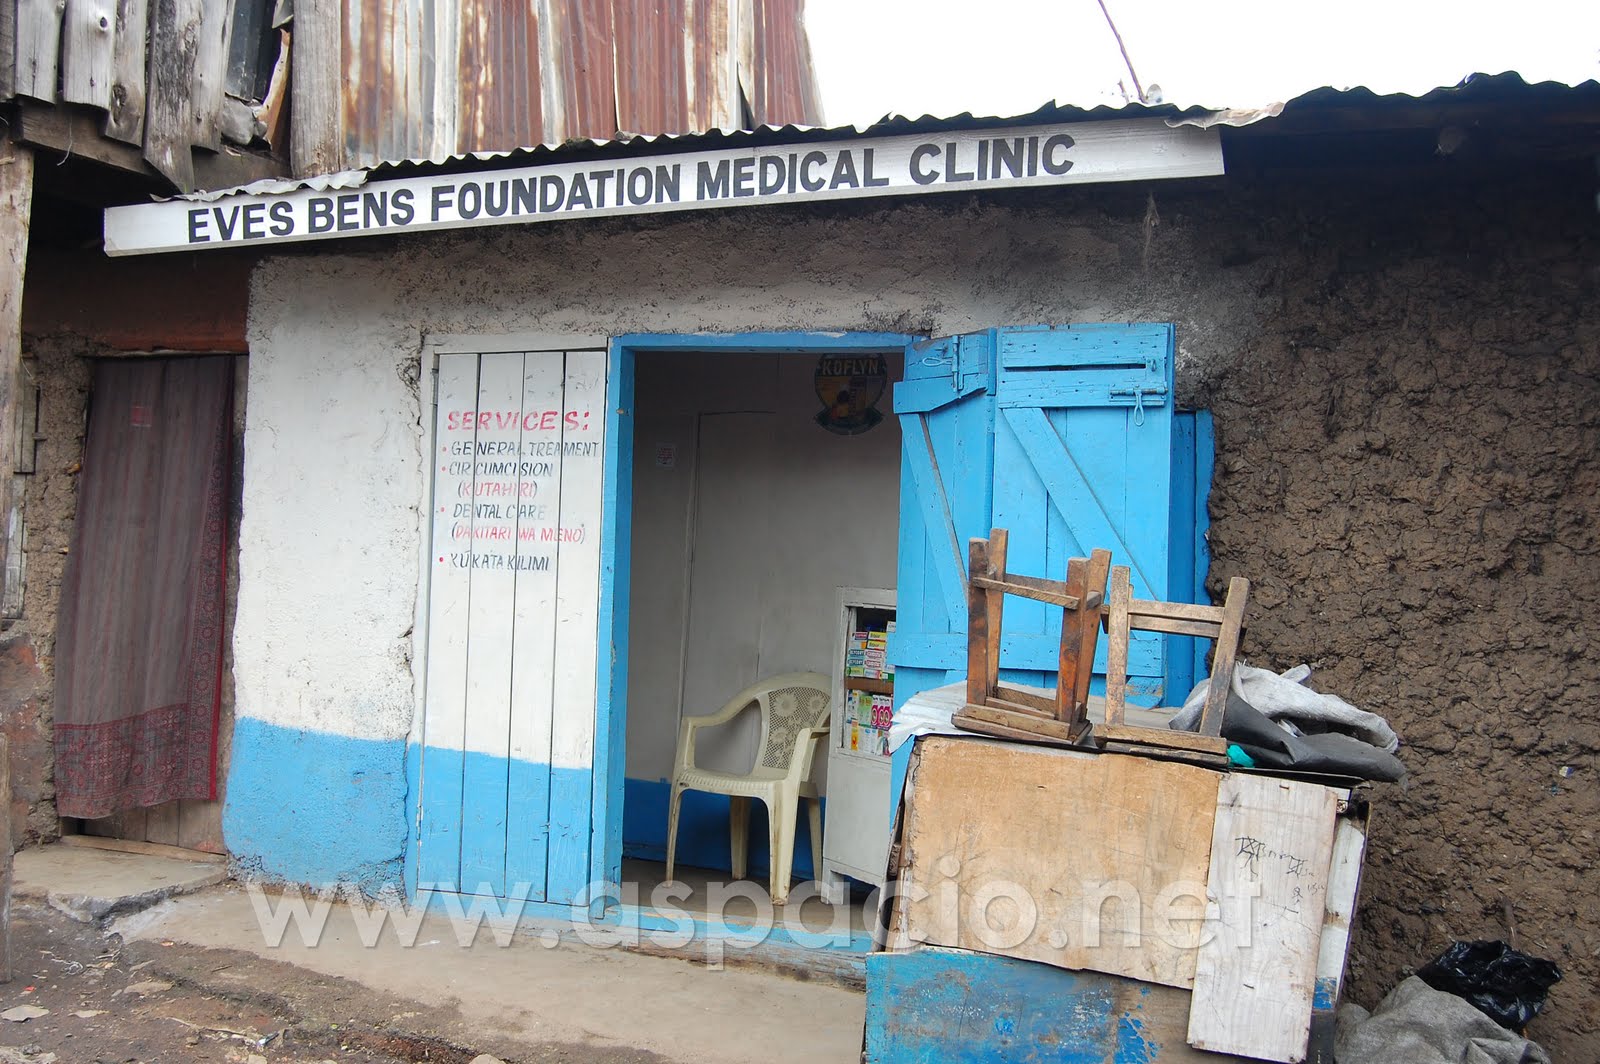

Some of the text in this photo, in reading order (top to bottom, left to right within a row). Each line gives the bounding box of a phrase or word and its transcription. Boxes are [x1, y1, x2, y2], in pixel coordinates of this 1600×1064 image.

[187, 134, 1076, 244] EVES BENS FOUNDATION MEDICAL CLINIC
[447, 410, 590, 431] SERVICES:
[451, 441, 600, 457] GENERAL TREAMENT
[449, 462, 553, 477] CIRCUMCISION
[453, 503, 548, 521] DENTAL CARE
[518, 528, 536, 542] WA
[507, 555, 549, 571] KILIMI
